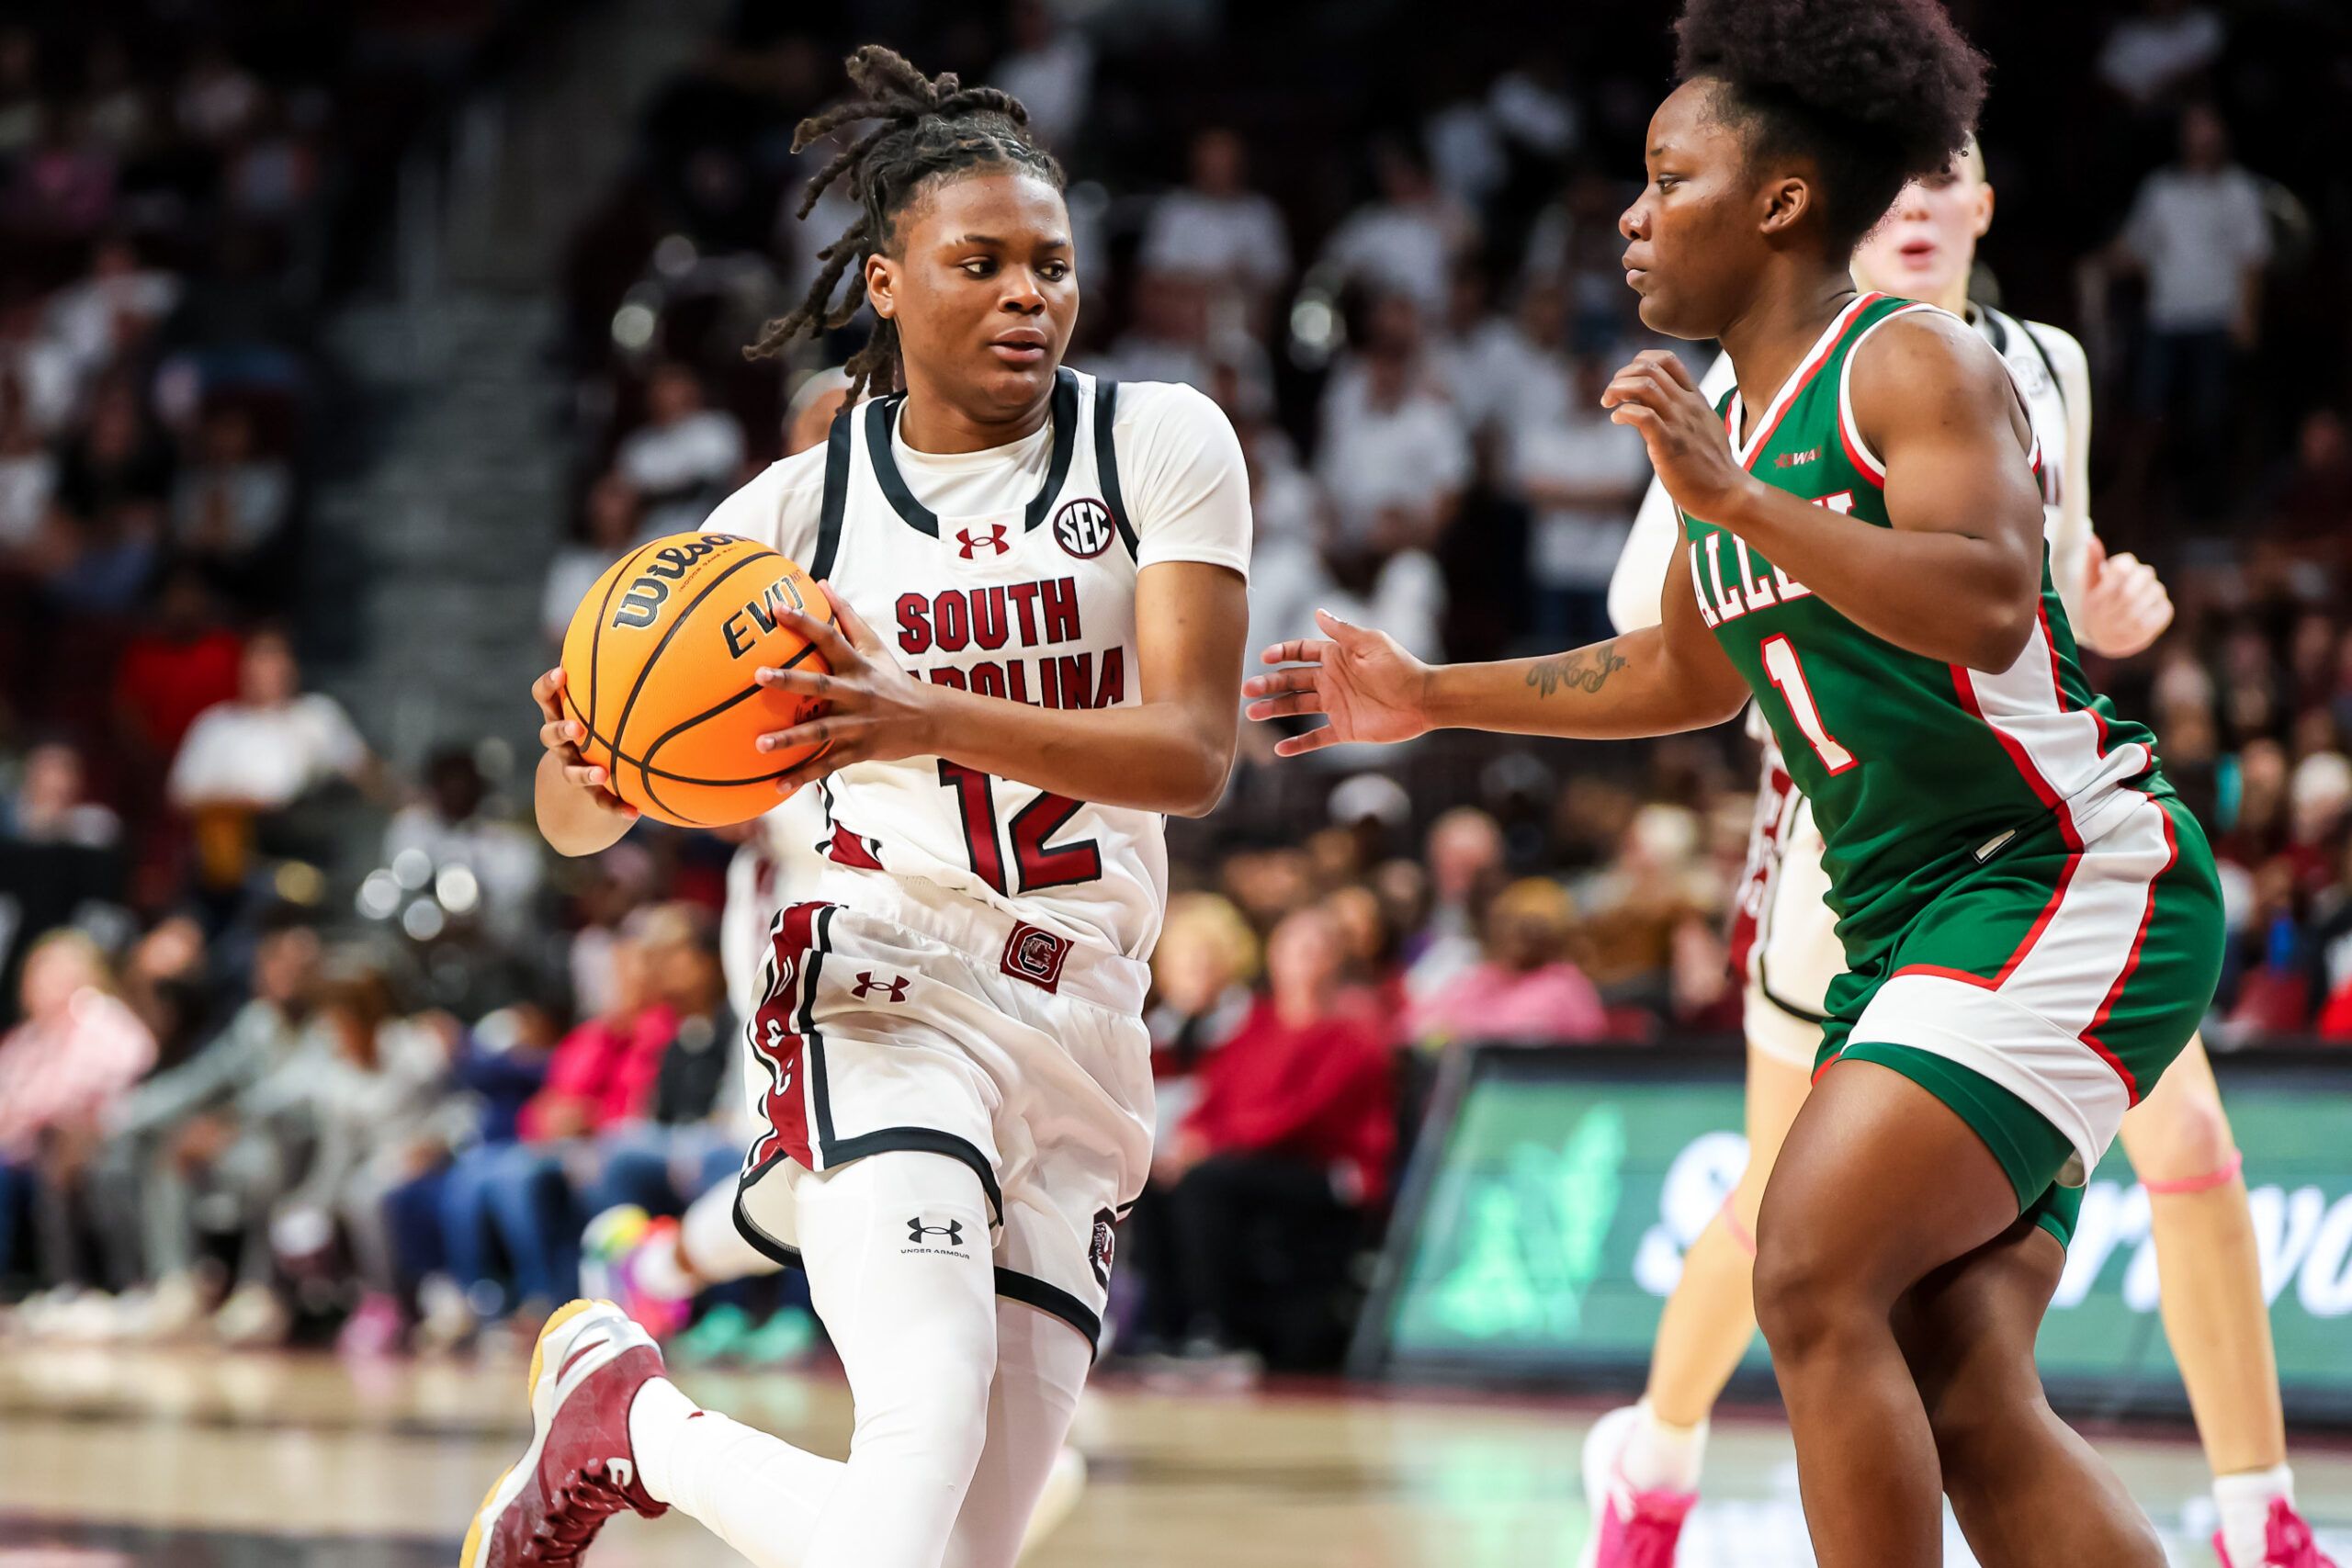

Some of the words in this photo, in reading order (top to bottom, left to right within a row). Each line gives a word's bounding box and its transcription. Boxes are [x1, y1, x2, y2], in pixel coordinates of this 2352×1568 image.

[1057, 502, 1110, 555] SEC
[894, 576, 1082, 655] SOUTH
[904, 646, 1125, 711] OLINA
[1760, 632, 1859, 777] 1
[937, 757, 1102, 898] 12
[933, 1248, 970, 1260] ARMOUR
